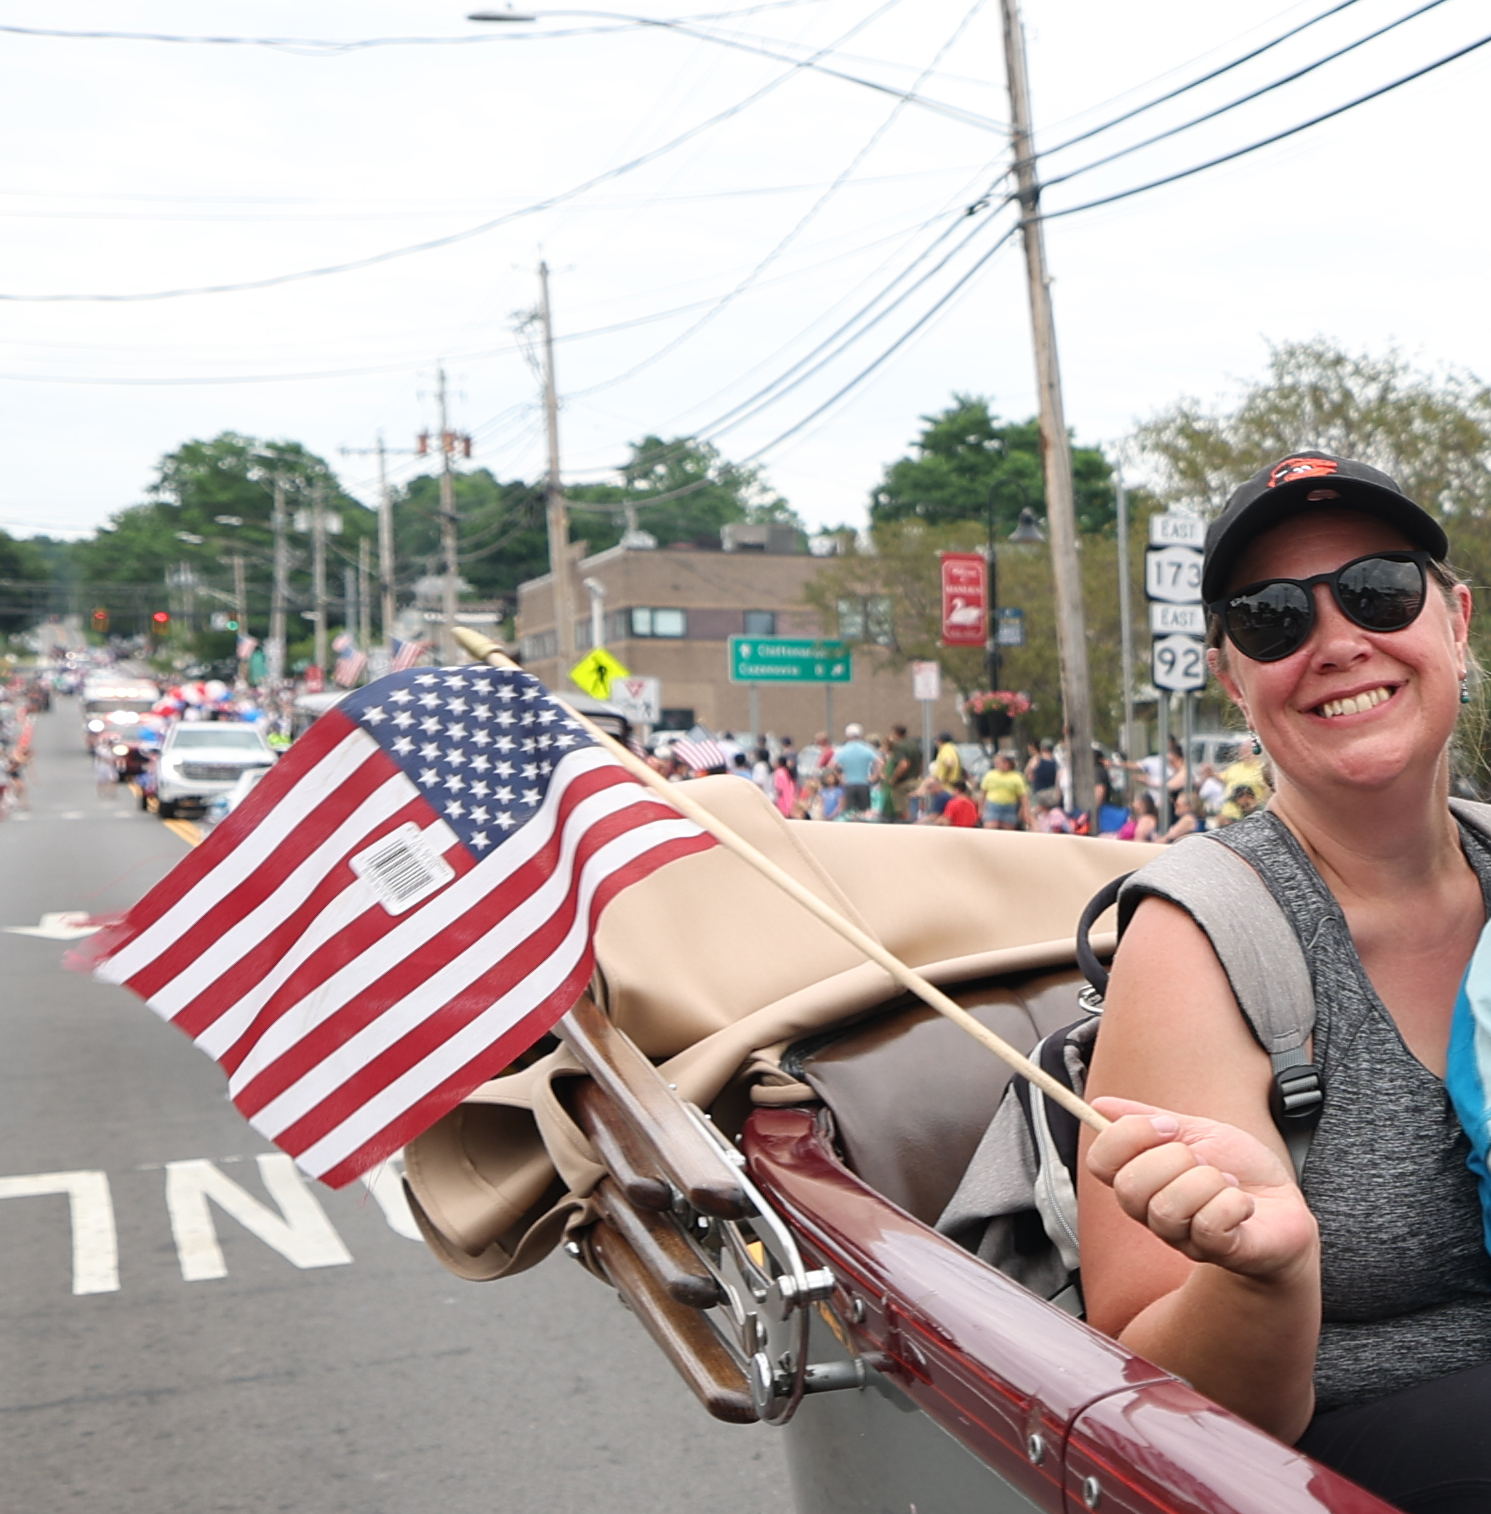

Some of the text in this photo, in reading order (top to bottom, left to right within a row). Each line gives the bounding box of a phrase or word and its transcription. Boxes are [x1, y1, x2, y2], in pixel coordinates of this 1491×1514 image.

[1161, 520, 1195, 539] EAST
[1155, 561, 1201, 588] 173
[1161, 606, 1195, 626] EAST
[1157, 647, 1201, 679] 92
